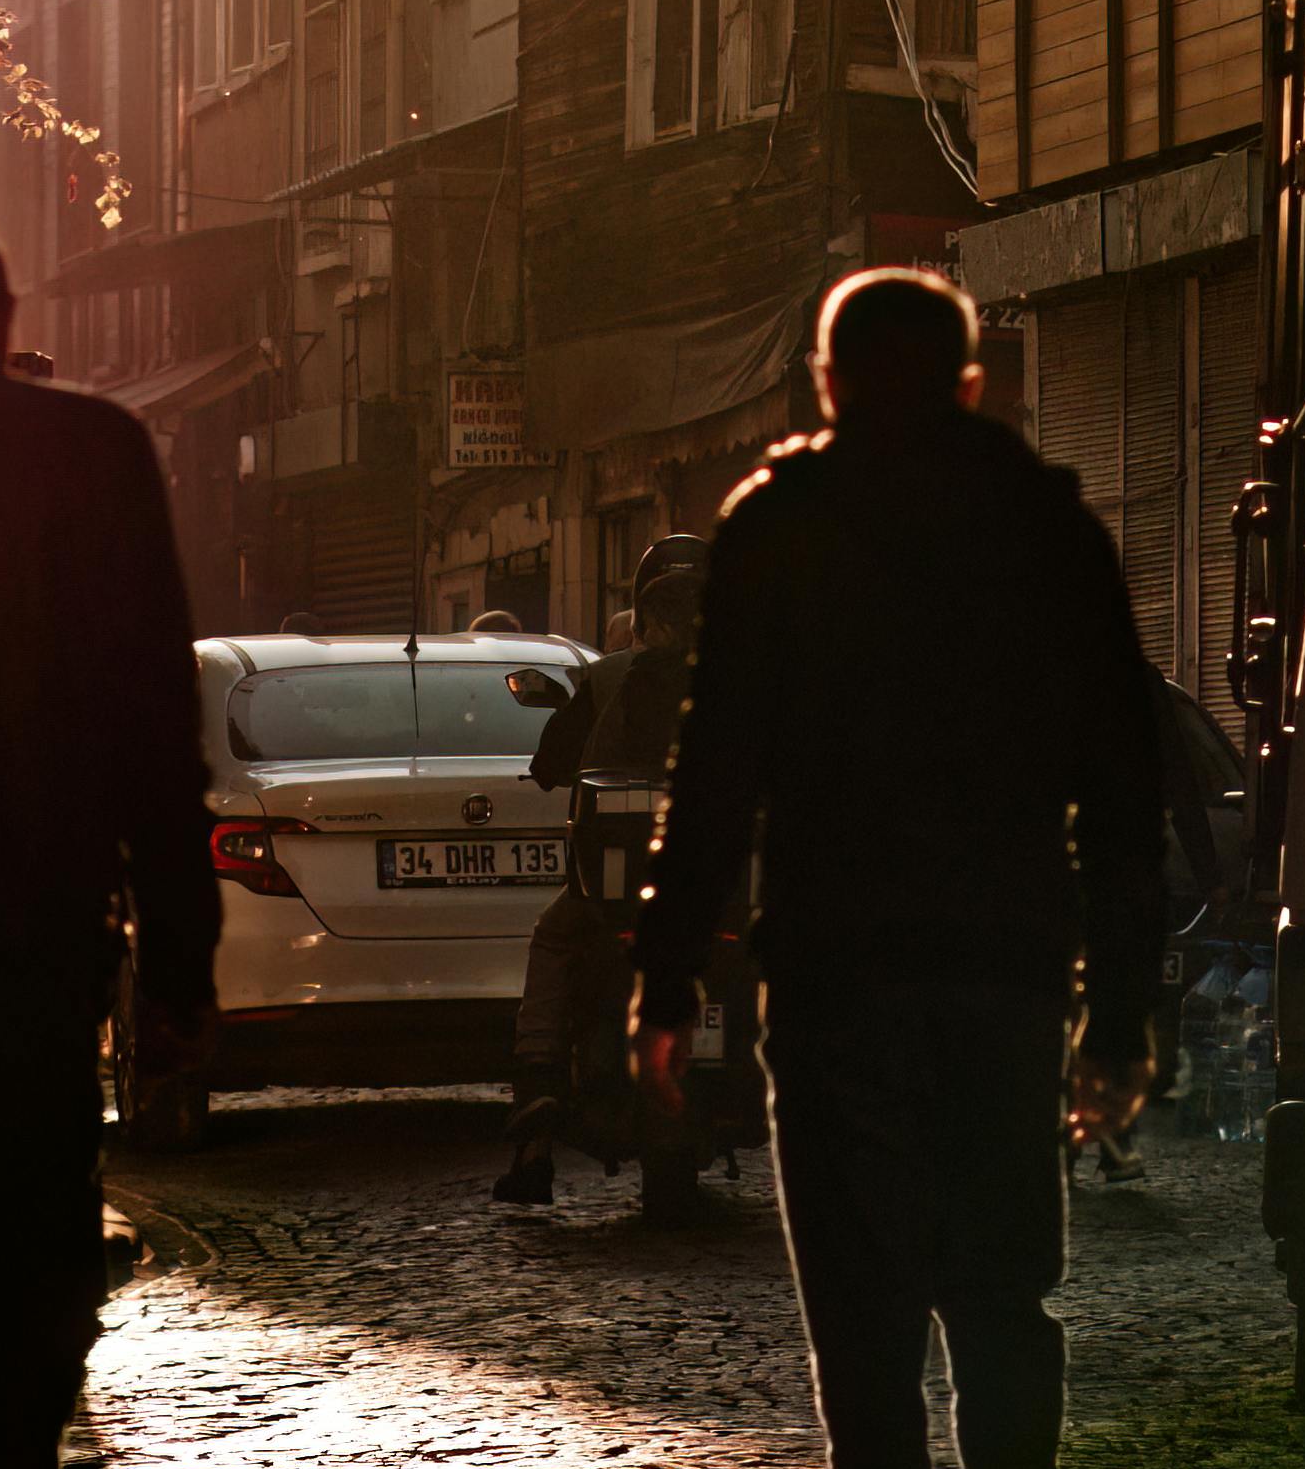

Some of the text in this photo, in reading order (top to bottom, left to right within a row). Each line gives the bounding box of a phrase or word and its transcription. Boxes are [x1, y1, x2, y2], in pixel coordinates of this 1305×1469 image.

[400, 846, 433, 875] 34
[445, 843, 496, 874] DHR
[511, 843, 559, 874] 135
